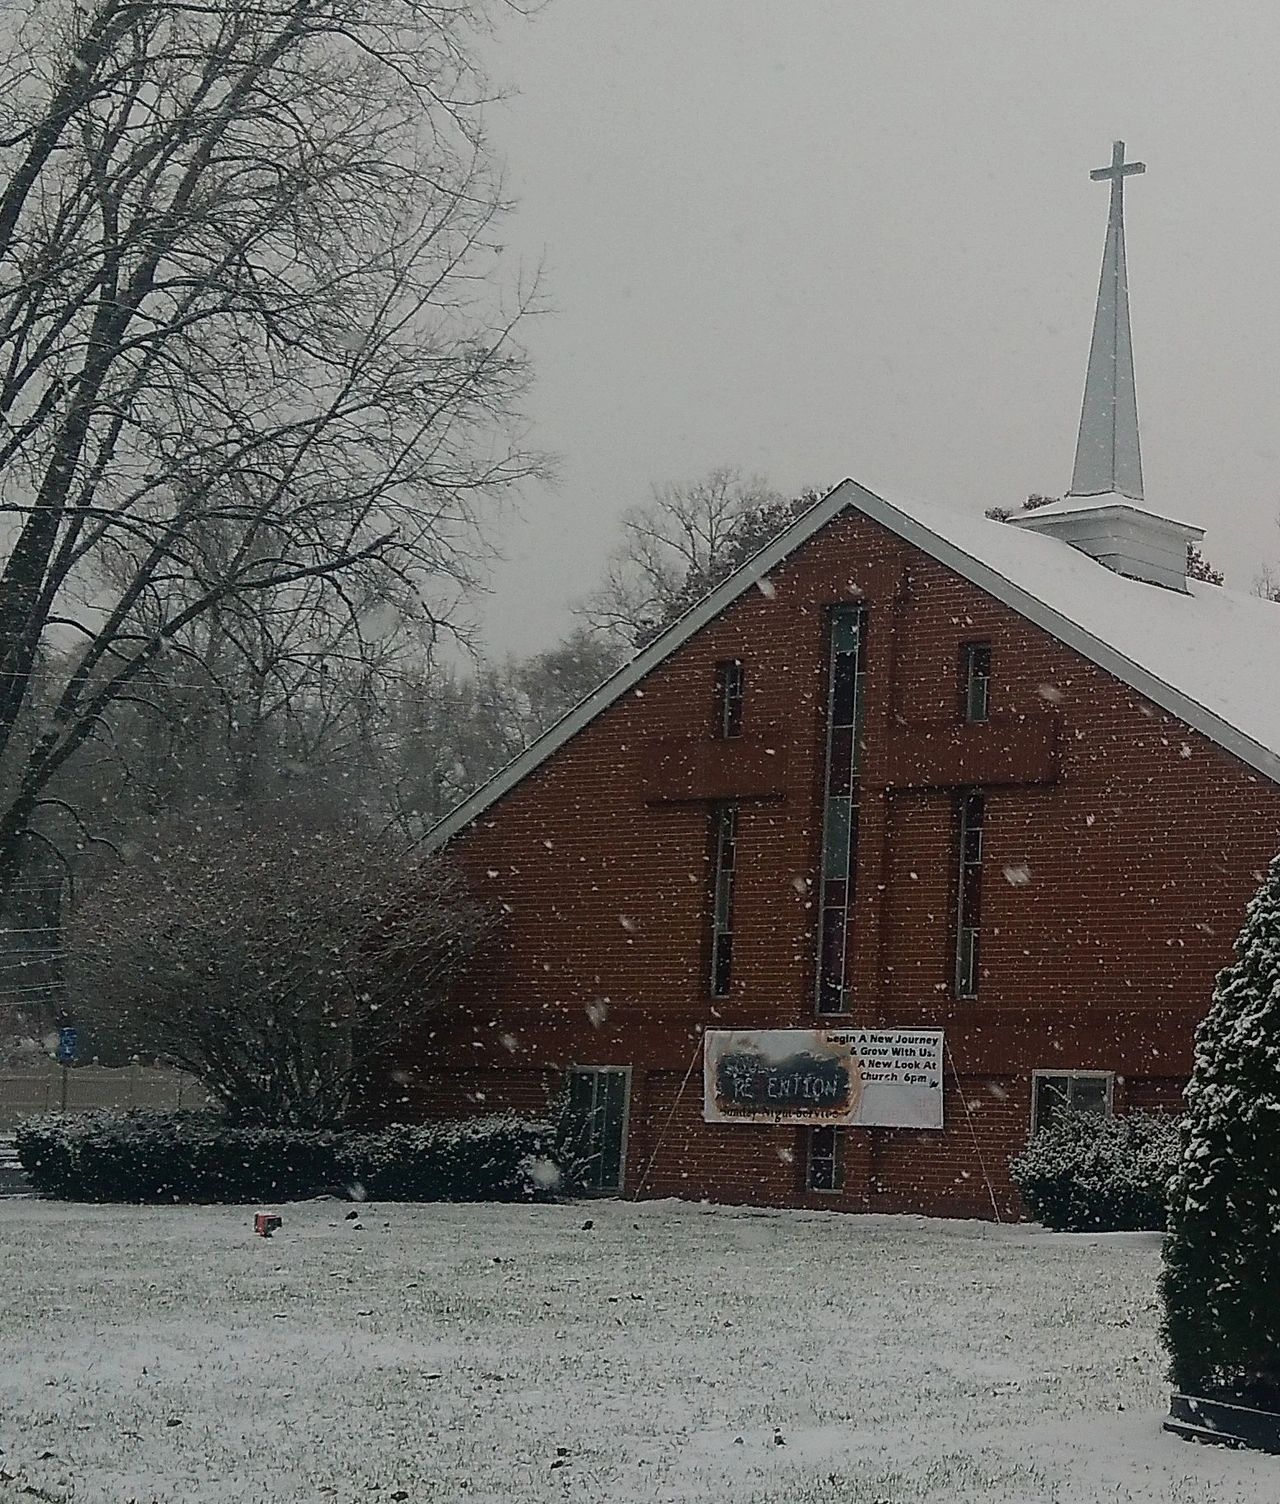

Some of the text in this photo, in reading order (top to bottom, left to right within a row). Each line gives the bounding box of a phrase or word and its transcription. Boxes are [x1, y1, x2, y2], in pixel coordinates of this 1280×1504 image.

[858, 1034, 867, 1043] A
[870, 1034, 893, 1044] New
[896, 1035, 939, 1046] Journey
[850, 1046, 936, 1057] & Grow With Us.
[857, 1060, 937, 1070] A New Look At
[860, 1072, 927, 1084] Church 6pm
